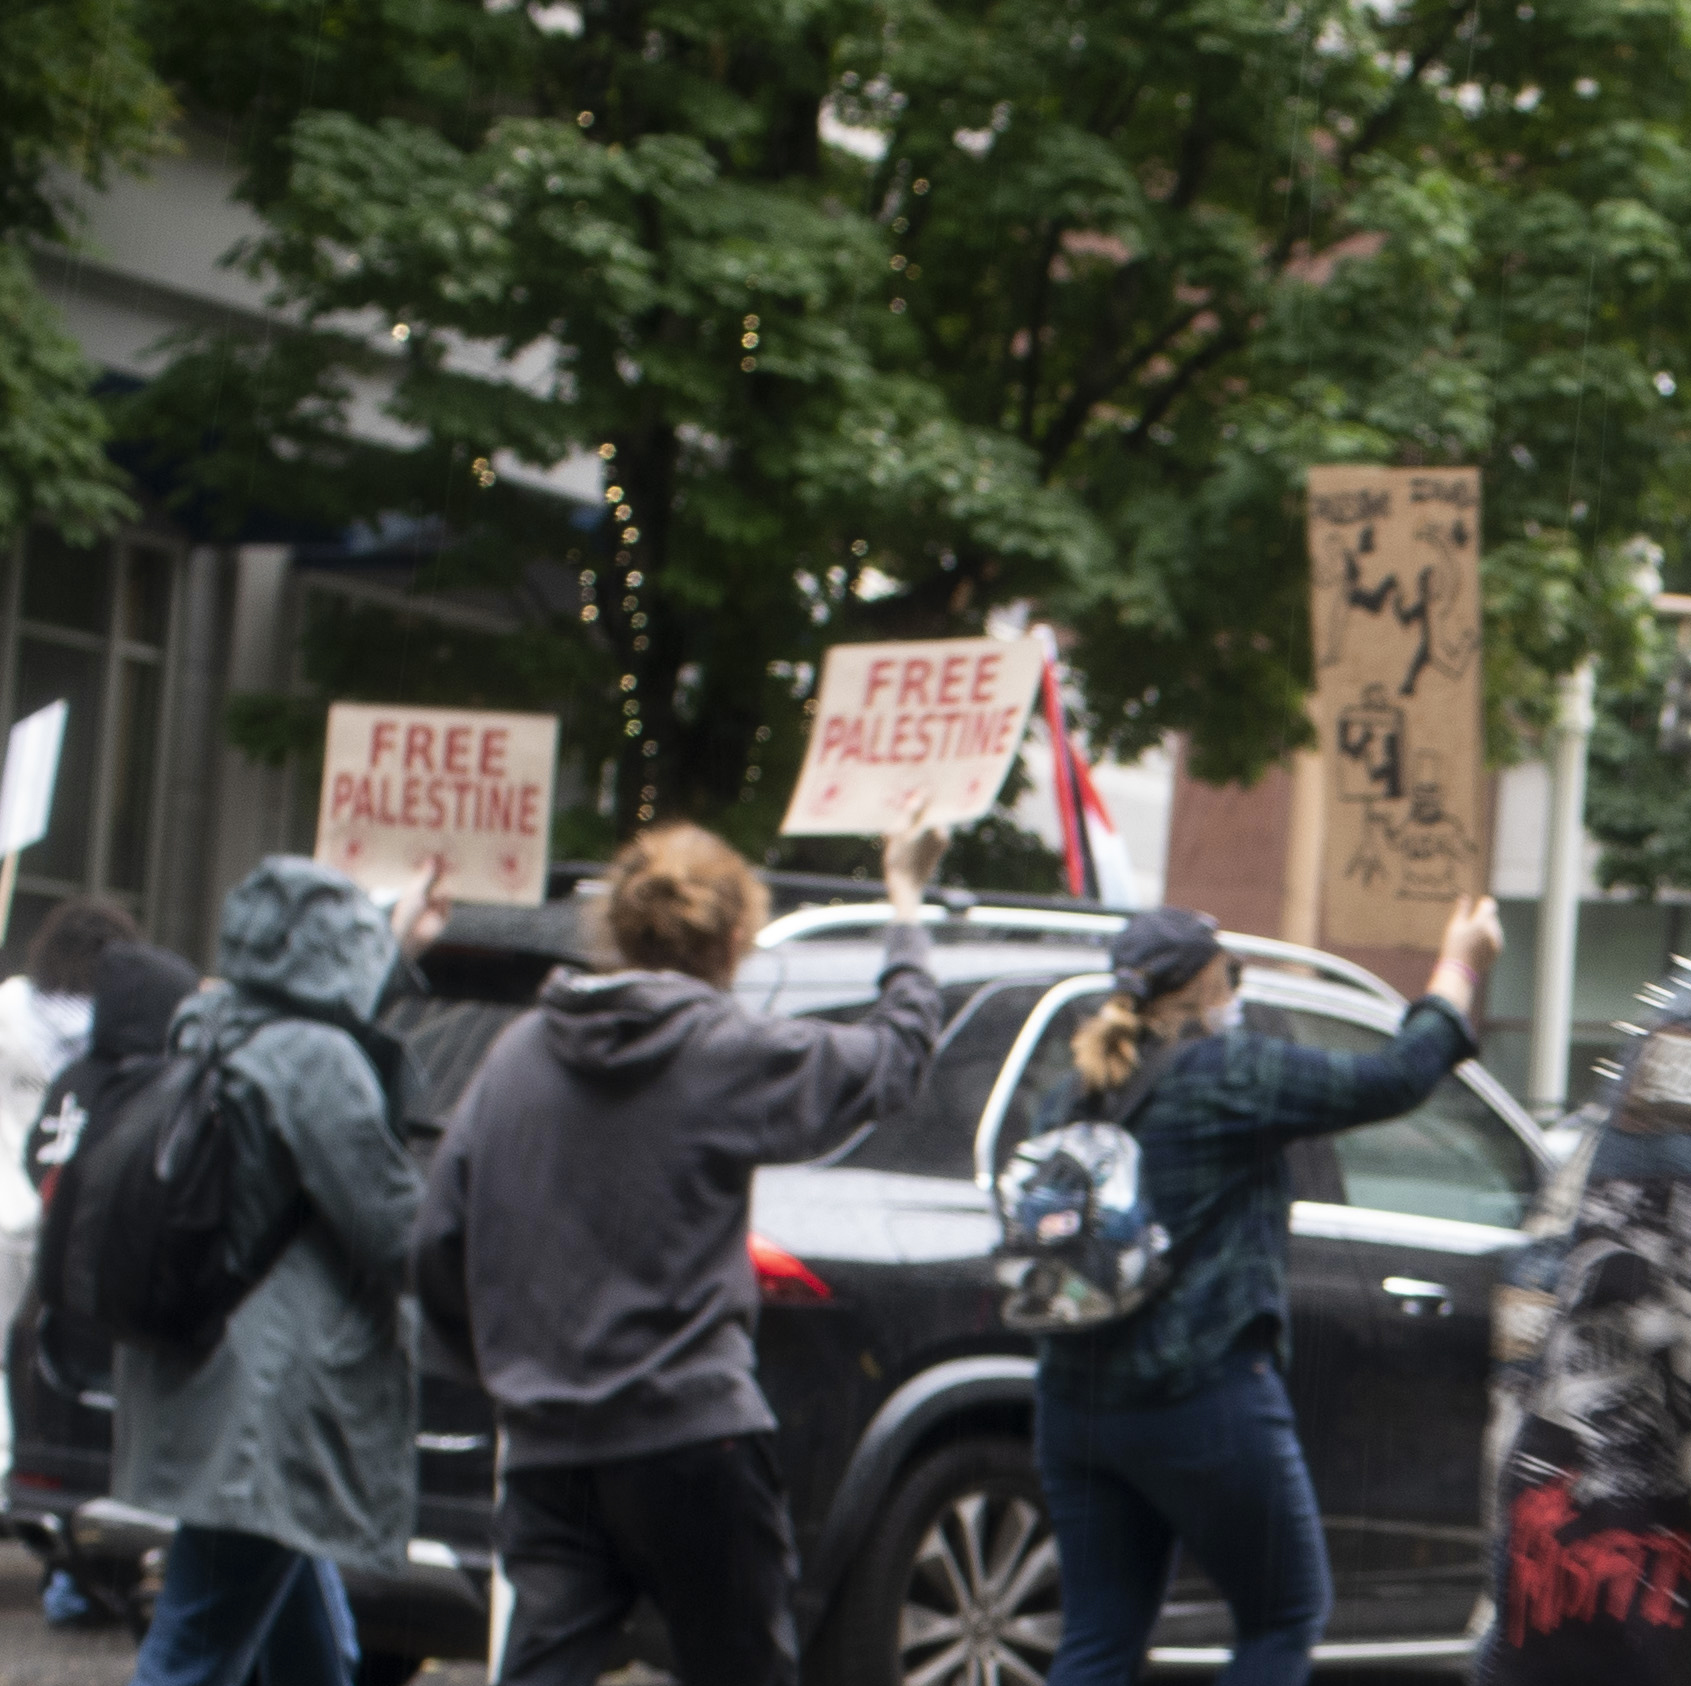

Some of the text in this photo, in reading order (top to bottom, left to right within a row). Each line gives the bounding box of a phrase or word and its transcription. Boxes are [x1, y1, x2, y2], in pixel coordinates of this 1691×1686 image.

[867, 654, 1002, 708] FREE
[370, 720, 509, 776] FREE
[819, 706, 1019, 766] PALESTINE
[331, 772, 540, 836] PALESTINE
